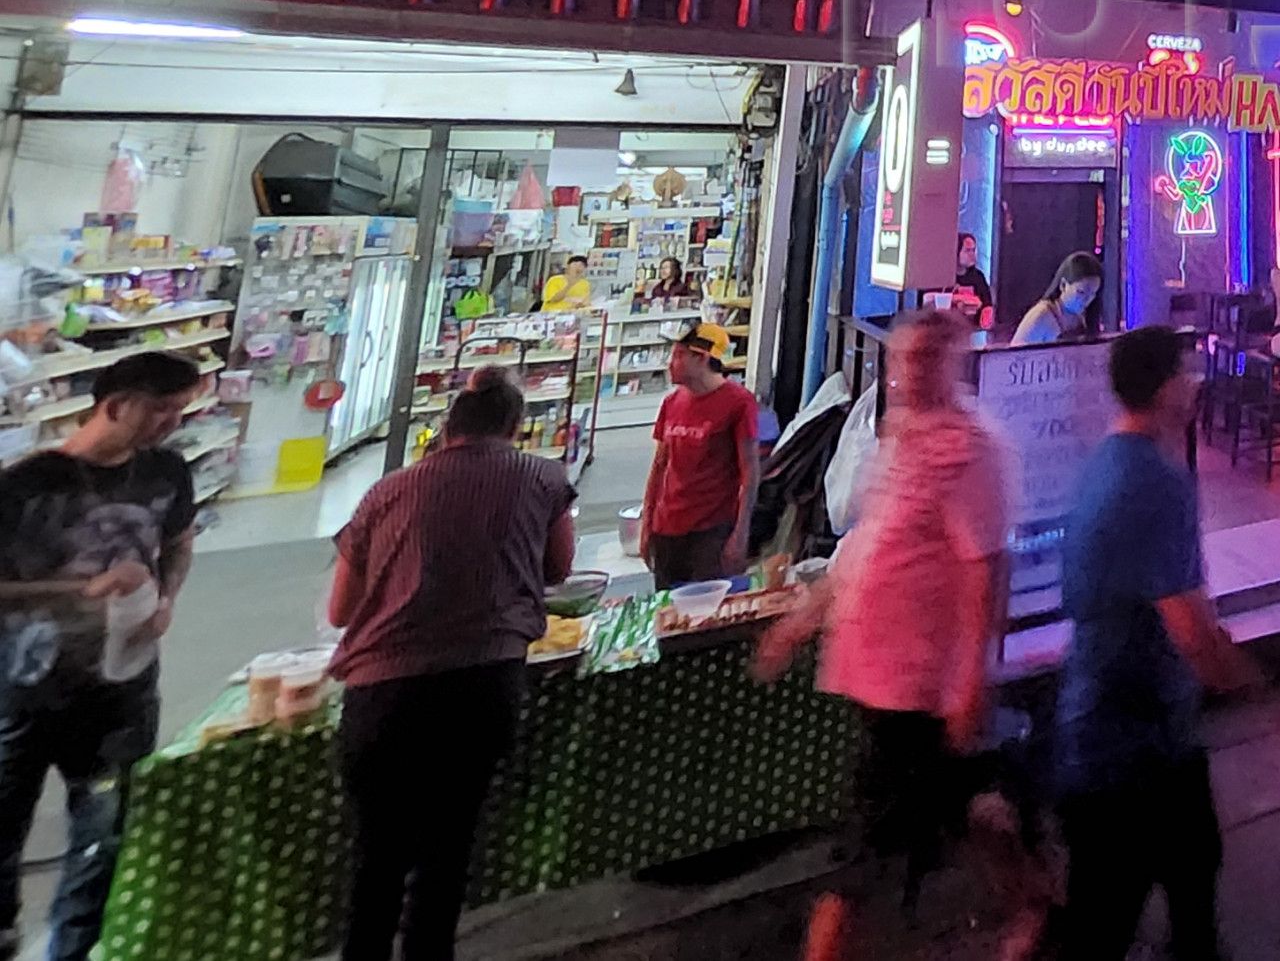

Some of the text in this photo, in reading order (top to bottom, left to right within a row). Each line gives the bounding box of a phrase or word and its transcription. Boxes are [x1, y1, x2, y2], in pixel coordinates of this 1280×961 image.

[1147, 34, 1202, 52] CERVEZA
[1020, 136, 1107, 156] by dundee
